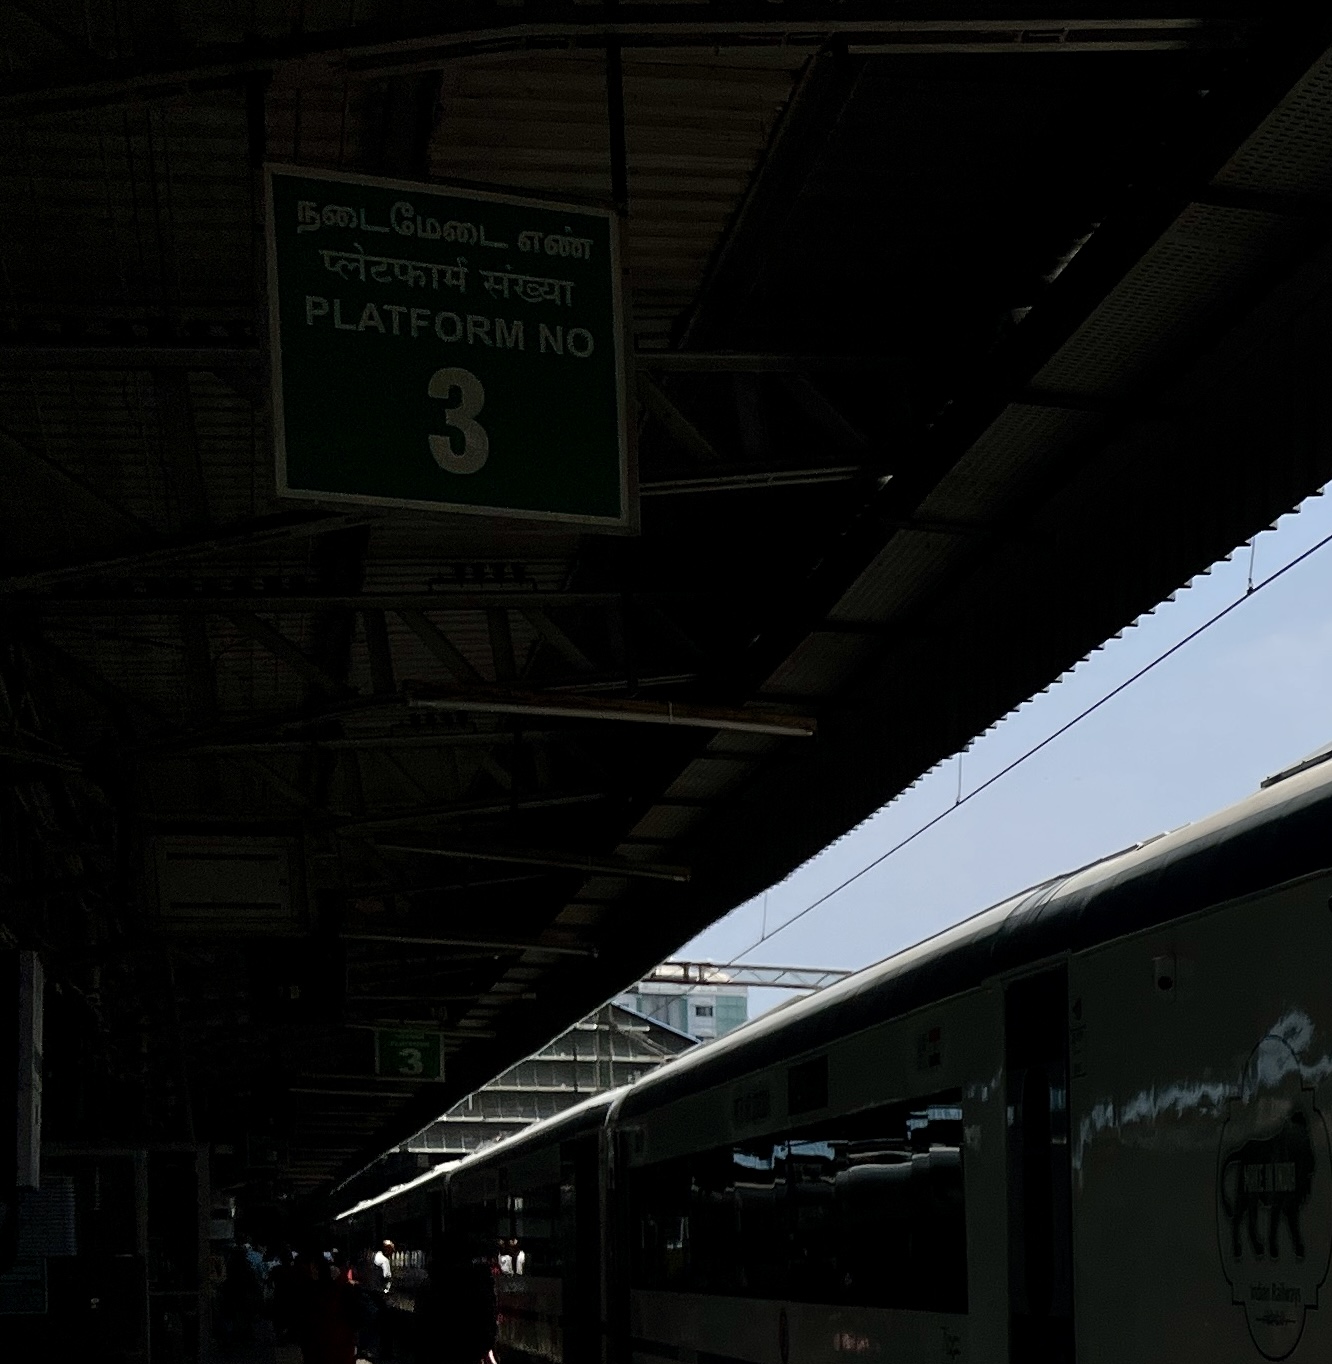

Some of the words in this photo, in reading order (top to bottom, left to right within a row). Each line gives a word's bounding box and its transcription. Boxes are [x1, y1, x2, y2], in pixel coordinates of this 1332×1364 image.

[297, 201, 509, 250] நடைமேடை
[518, 225, 595, 260] எண்
[318, 242, 470, 293] प्लेटफार्म
[478, 264, 575, 307] संख्या
[305, 295, 526, 350] PLATFORM
[538, 323, 595, 359] NO
[427, 367, 489, 474] 3
[398, 1047, 424, 1075] 3
